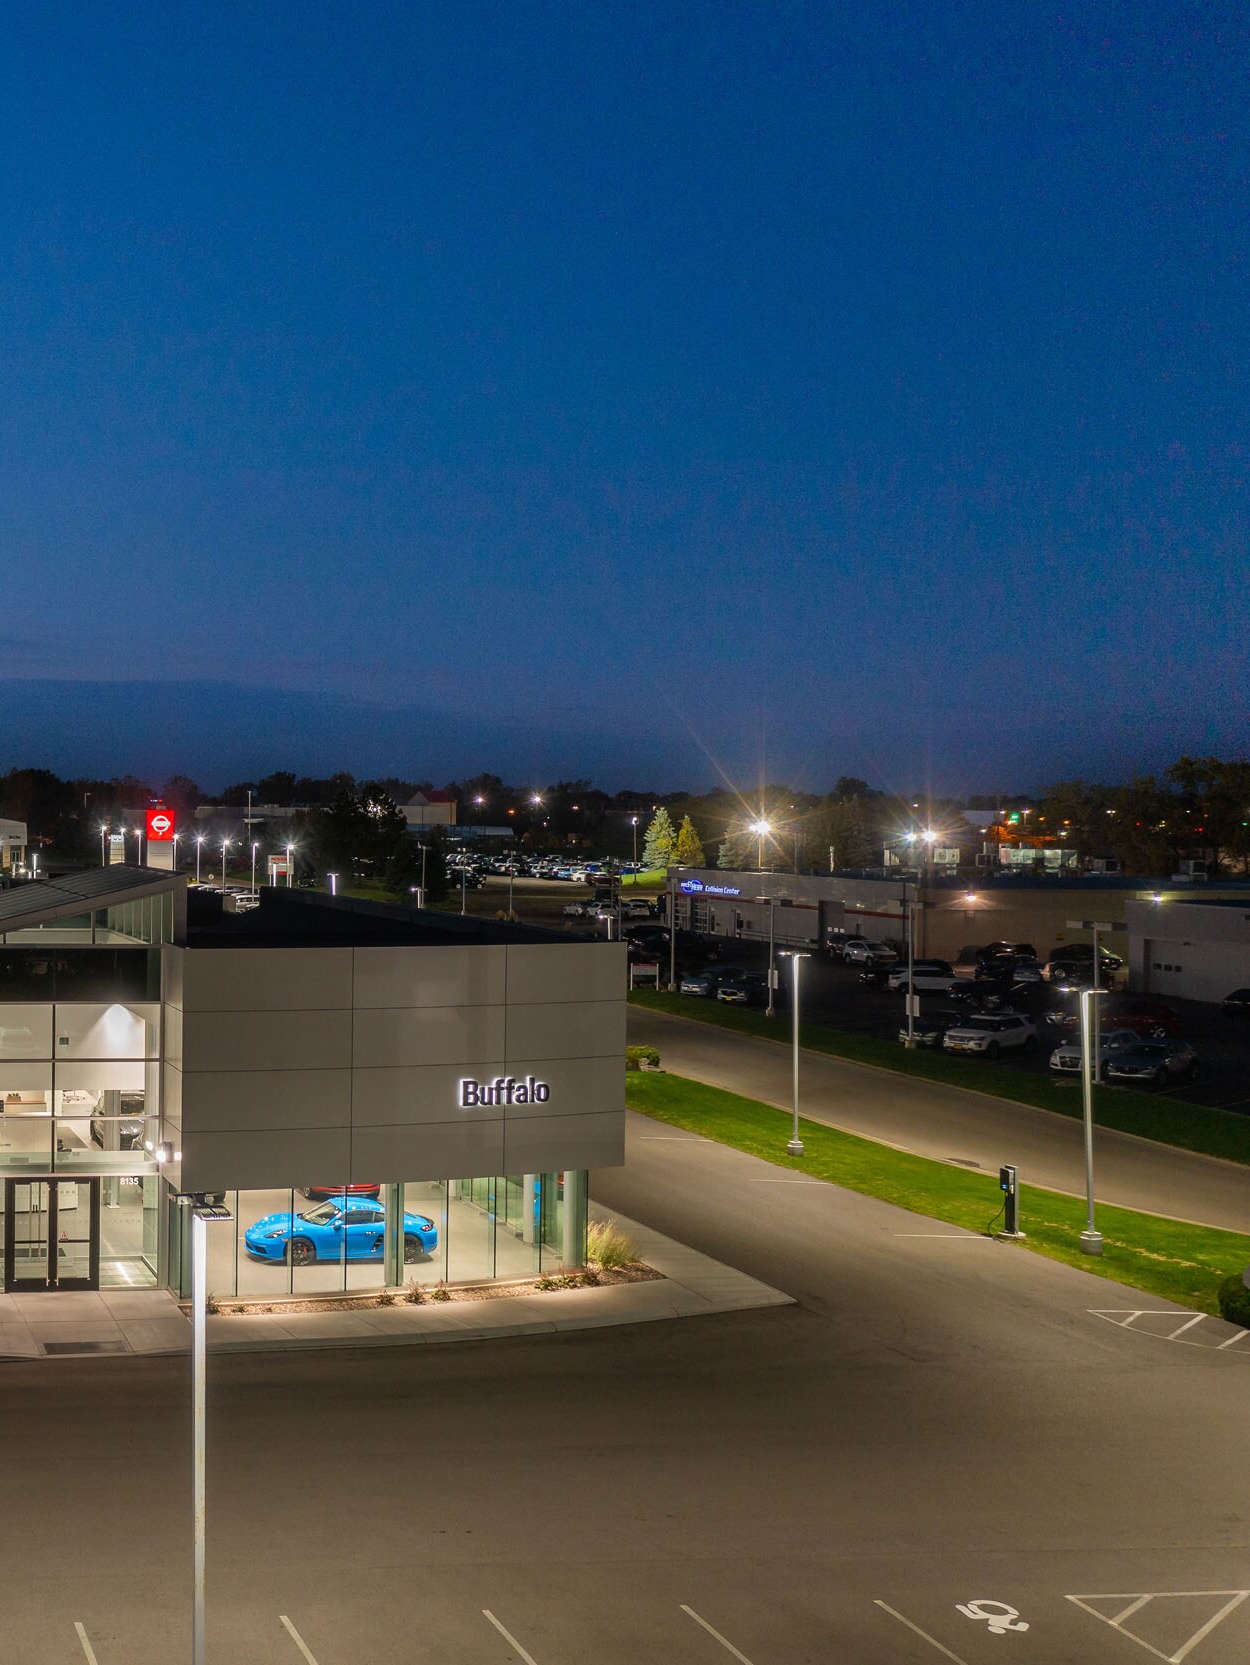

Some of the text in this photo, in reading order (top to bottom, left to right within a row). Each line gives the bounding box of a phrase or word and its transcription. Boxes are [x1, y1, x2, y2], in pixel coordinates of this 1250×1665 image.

[705, 885, 740, 895] Collision Center
[460, 1076, 550, 1106] Buffalo
[120, 1177, 139, 1185] 8135
